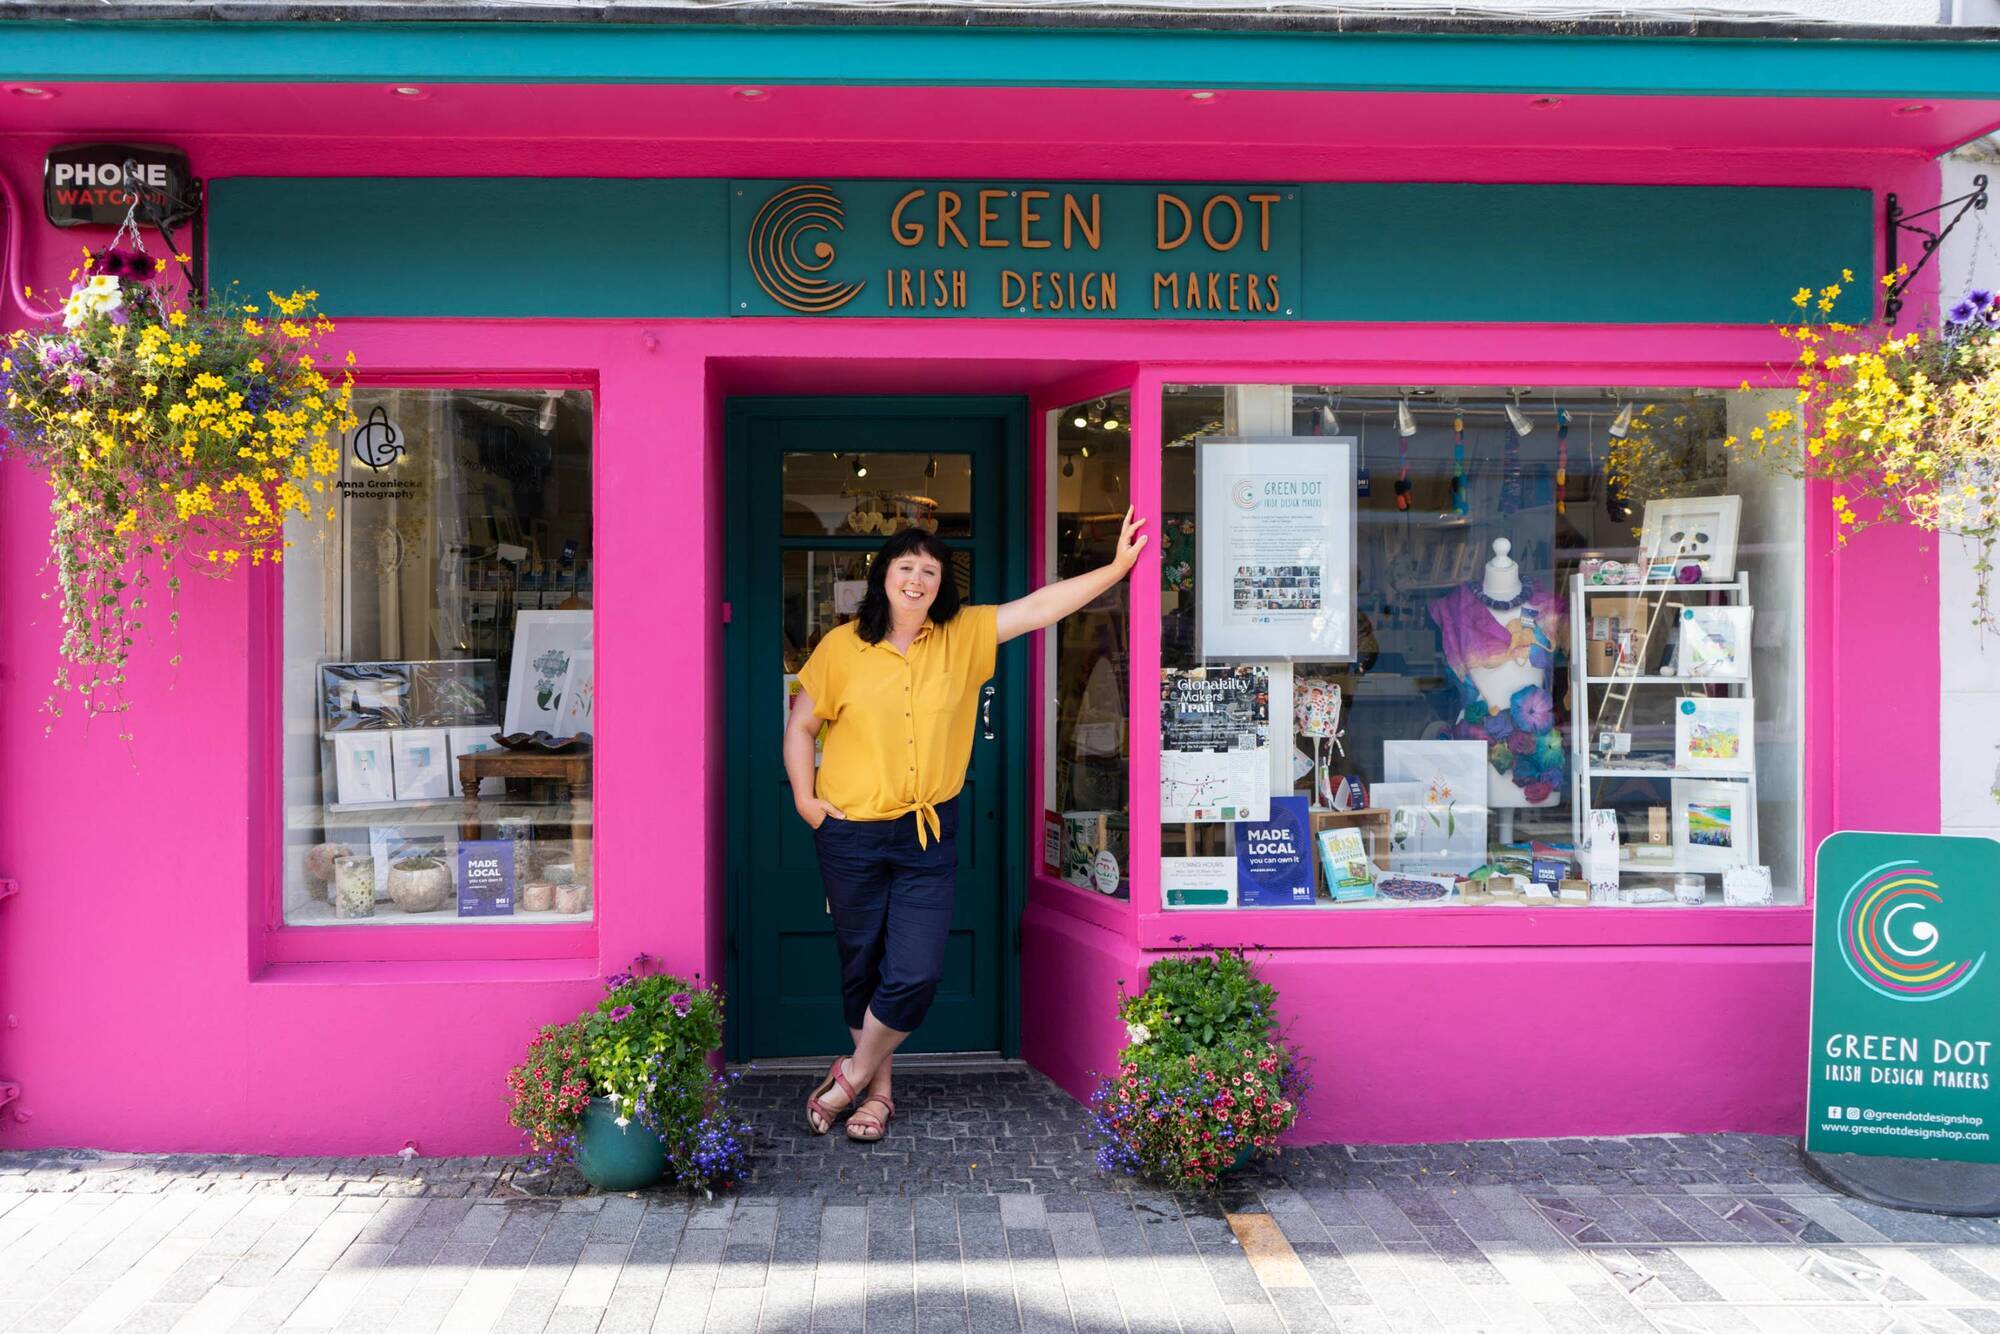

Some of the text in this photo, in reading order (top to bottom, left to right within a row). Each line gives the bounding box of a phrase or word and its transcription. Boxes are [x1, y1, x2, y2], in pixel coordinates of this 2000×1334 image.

[55, 163, 167, 187] PHONE
[890, 189, 1281, 252] GREEN DOT
[887, 268, 1281, 313] IRISH DESIGN MAKERS
[336, 479, 423, 489] Anna Groniecka
[1264, 481, 1322, 495] GREEN DOT
[343, 490, 416, 500] Photography
[1177, 677, 1251, 694] Clonakilty
[1180, 690, 1224, 702] Makers
[1247, 829, 1290, 841] MADE
[1248, 843, 1296, 855] LOCAL
[468, 859, 498, 868] MADE
[468, 869, 502, 877] LOCAL
[1825, 1033, 1992, 1066] GREEN DOT
[1825, 1064, 1990, 1090] IRISH DESIGN MAKERS
[1862, 1108, 1984, 1127] @greendotdesignshop
[1821, 1122, 1990, 1142] www.greendotdesignshop.com
